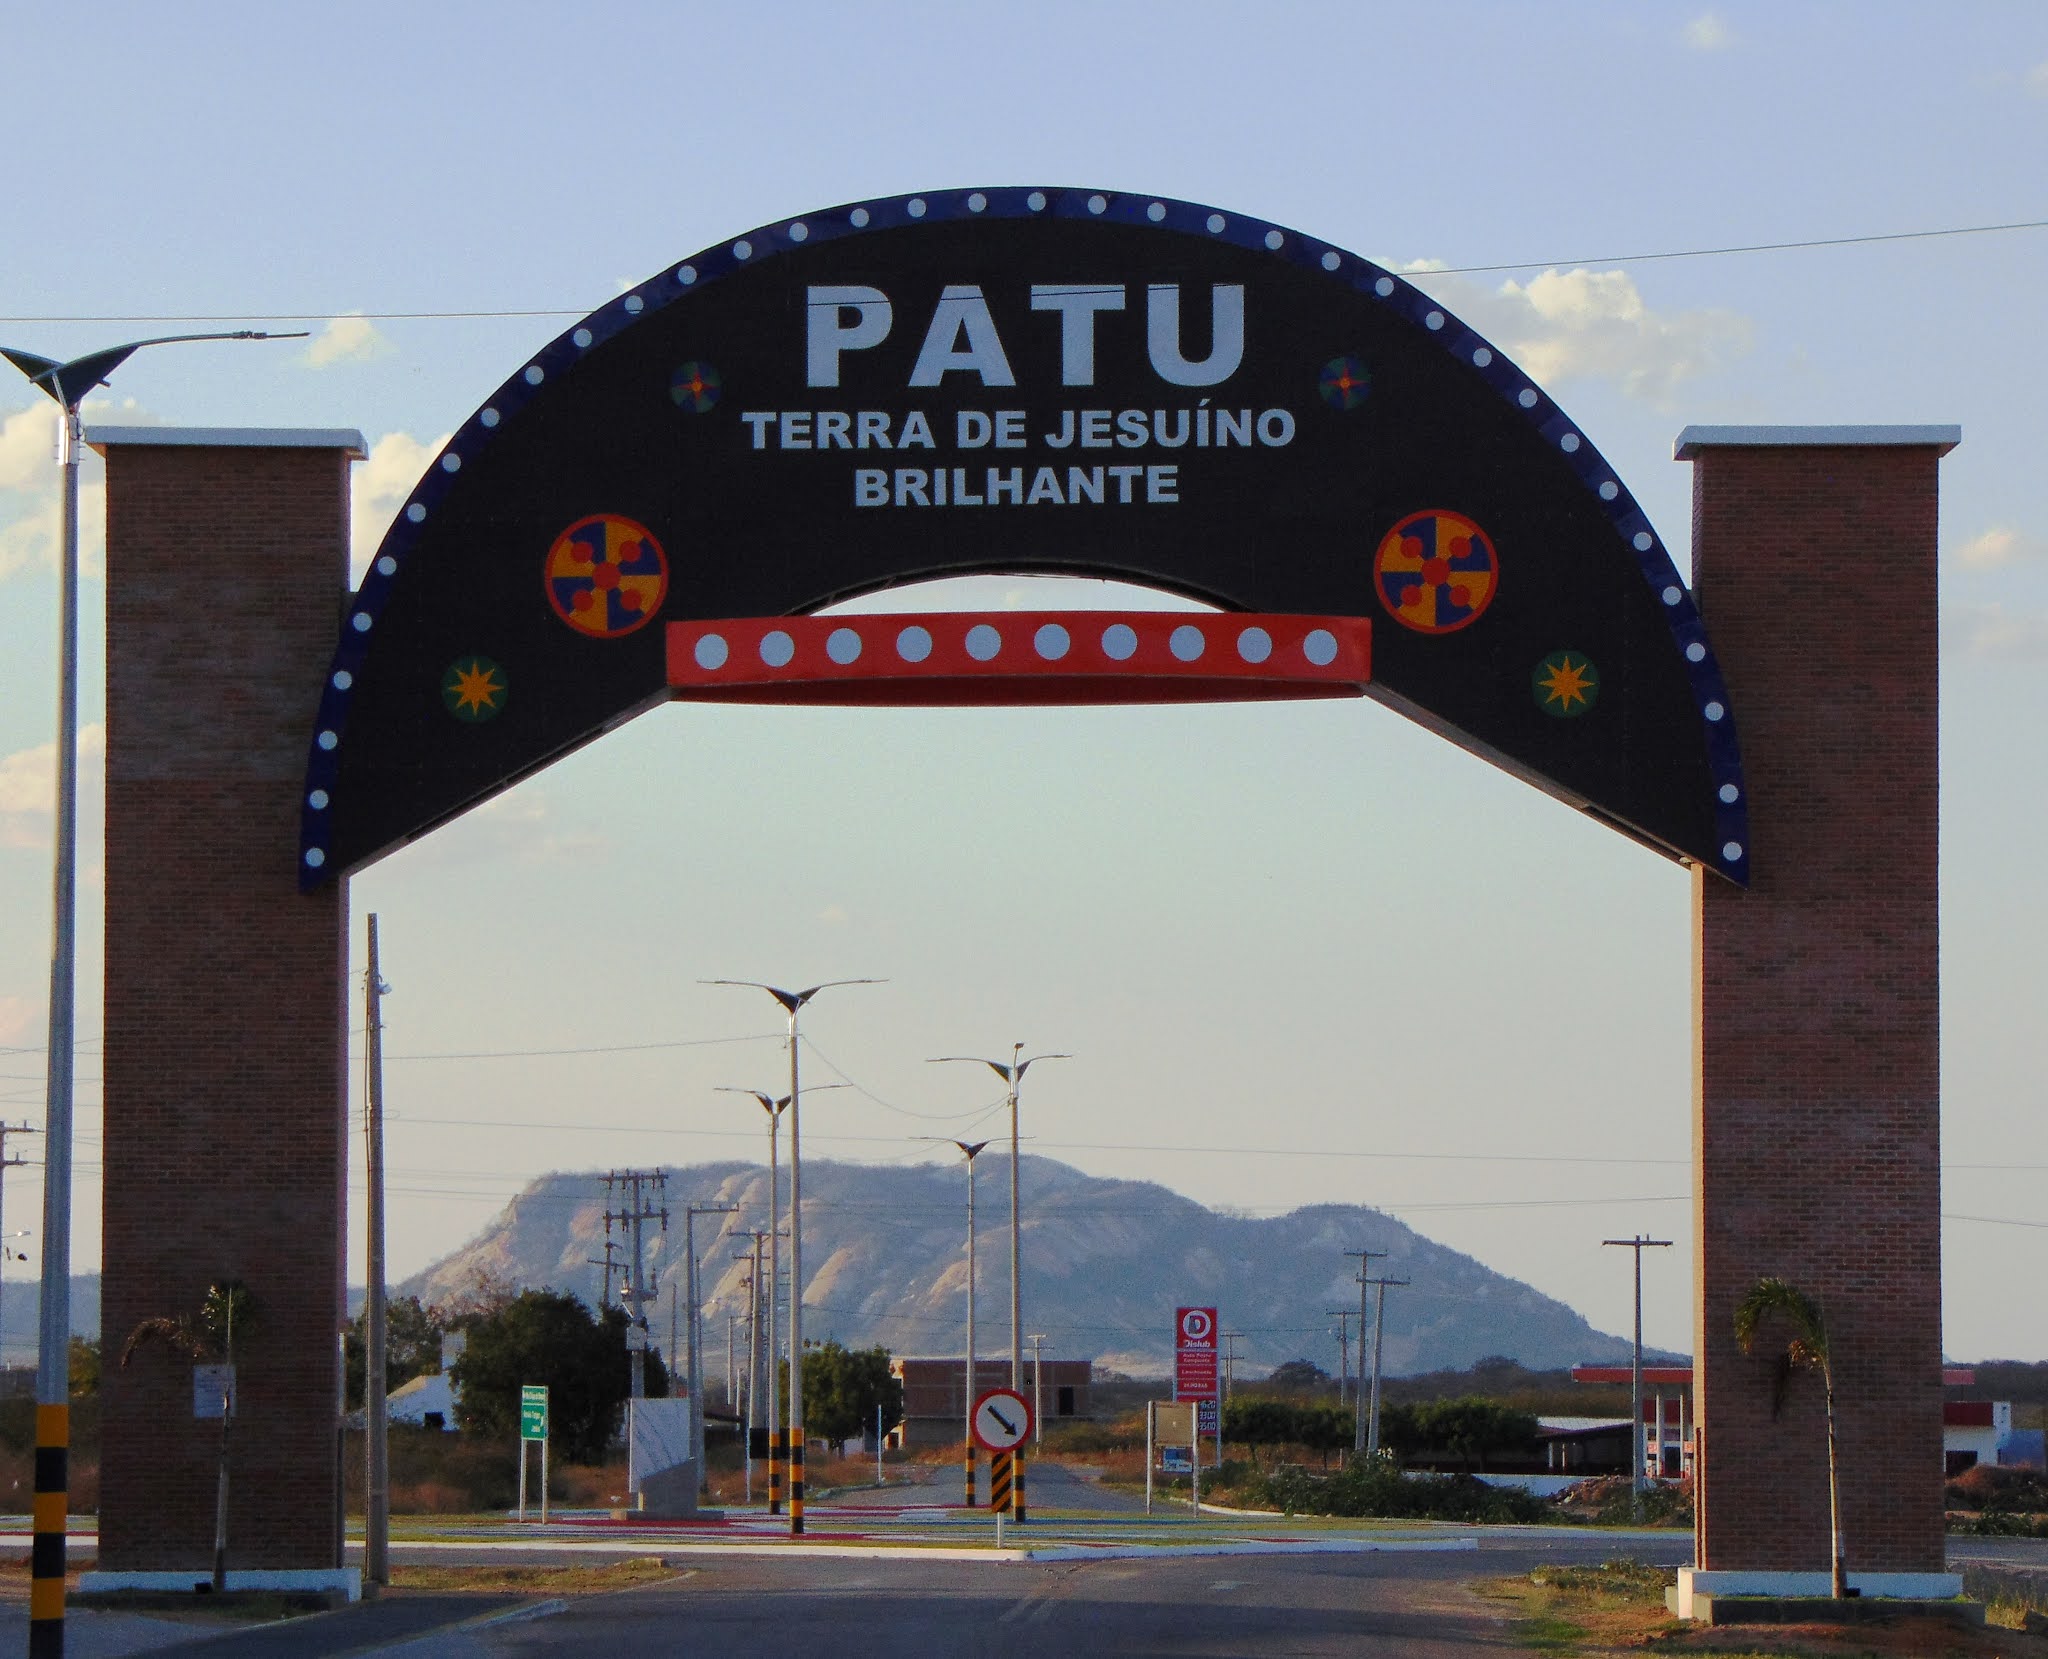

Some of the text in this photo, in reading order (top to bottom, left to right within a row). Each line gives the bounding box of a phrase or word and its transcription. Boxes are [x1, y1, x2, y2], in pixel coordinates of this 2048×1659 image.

[807, 283, 1245, 388] PATU
[742, 398, 1296, 450] TERRA DE JESUÍNO
[855, 465, 1179, 507] BRILHANTE
